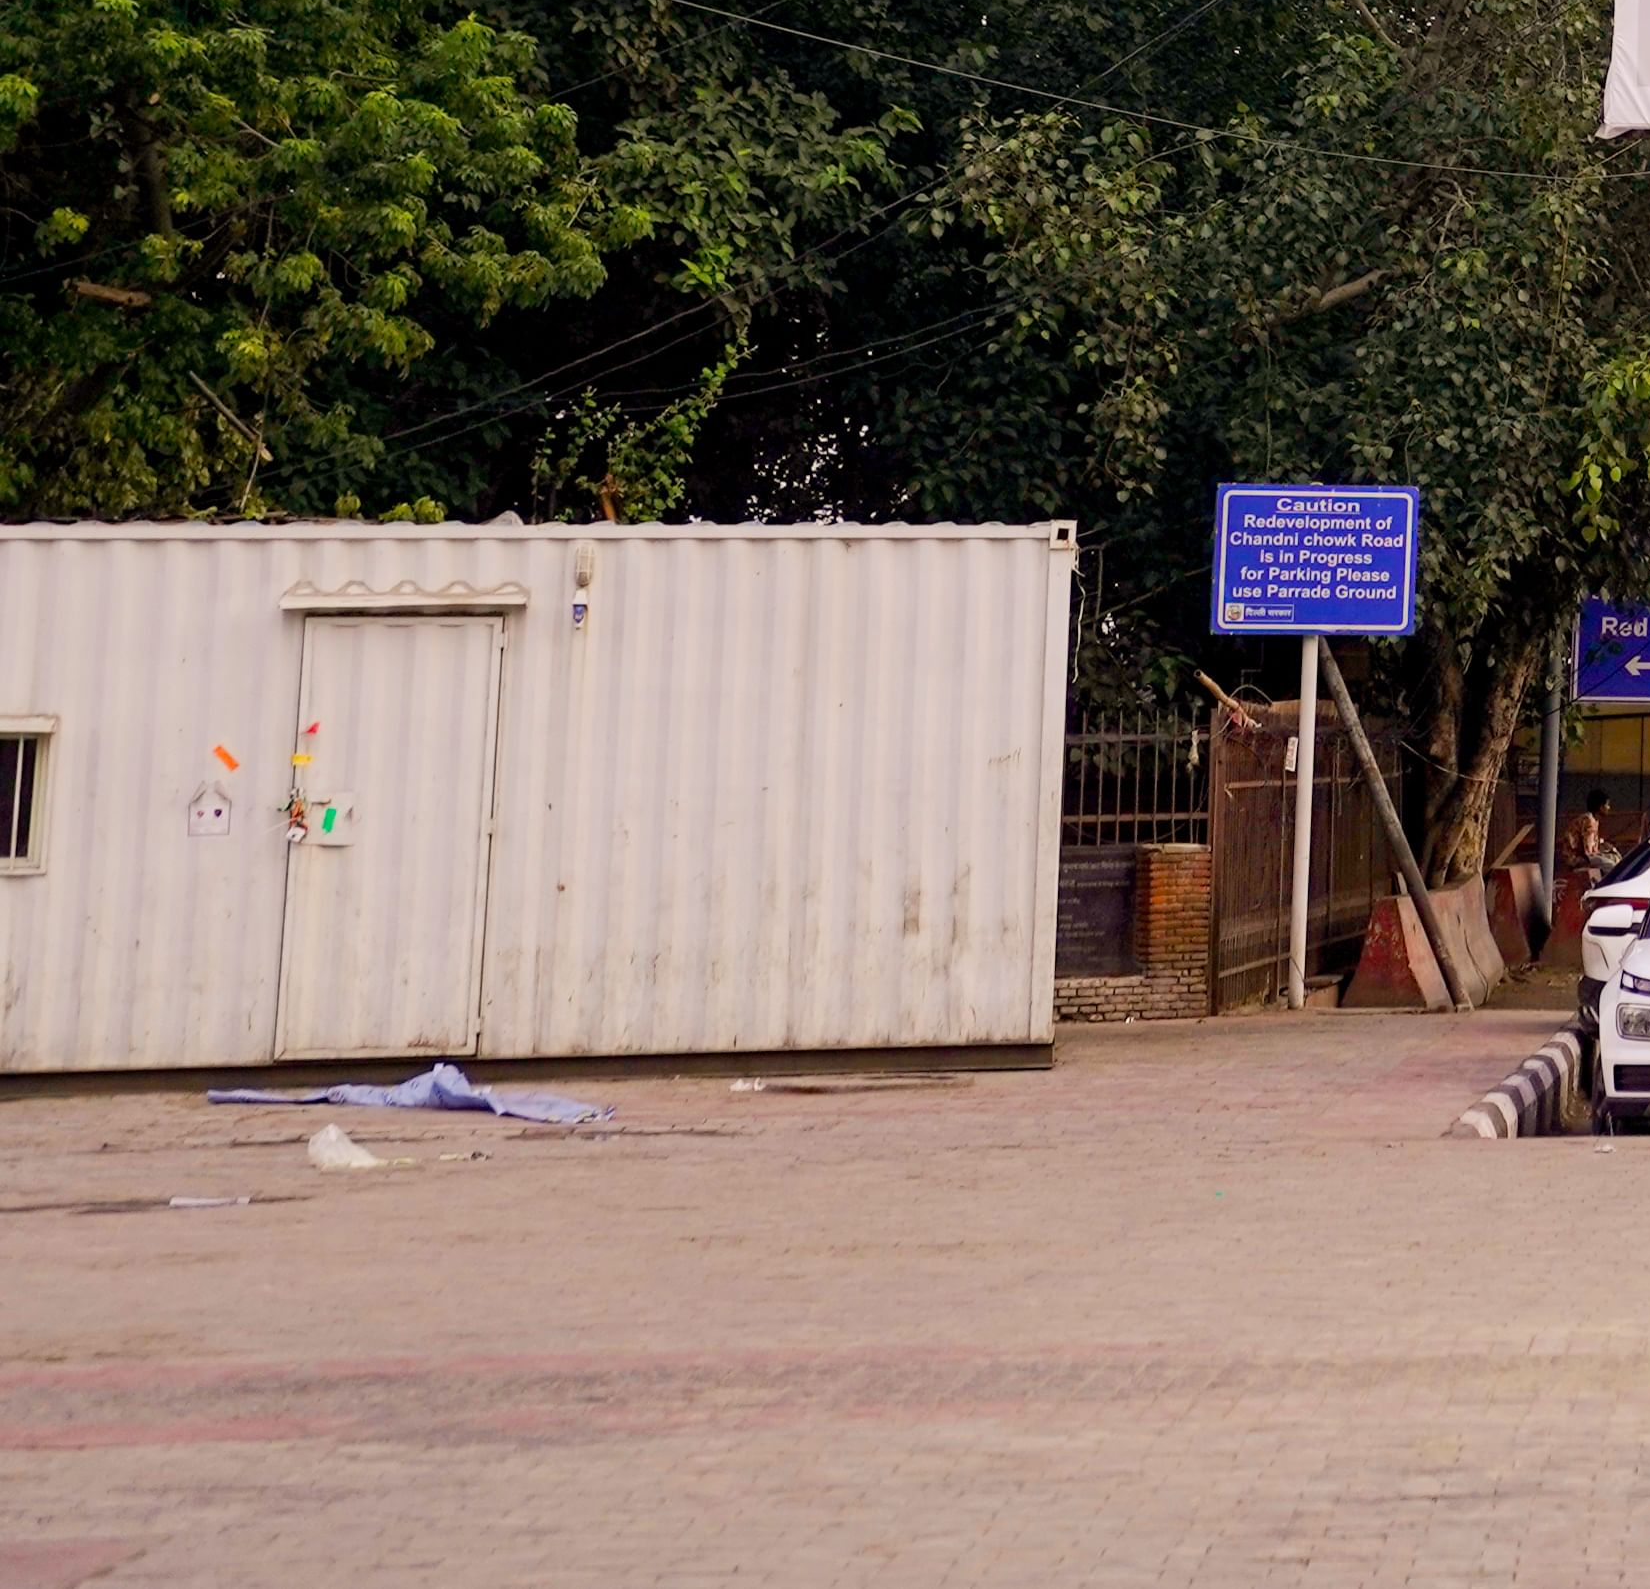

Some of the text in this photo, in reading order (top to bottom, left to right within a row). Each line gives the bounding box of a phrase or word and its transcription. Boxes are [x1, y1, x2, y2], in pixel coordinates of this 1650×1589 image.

[1276, 497, 1361, 513] Caution
[1243, 514, 1393, 532] Redevelopment of
[1229, 531, 1404, 548] Chandni chowk Road
[1259, 549, 1373, 567] is in Progress
[1240, 566, 1390, 584] for Parking Please
[1232, 584, 1397, 600] use Parrade Ground
[1601, 616, 1648, 638] Red
